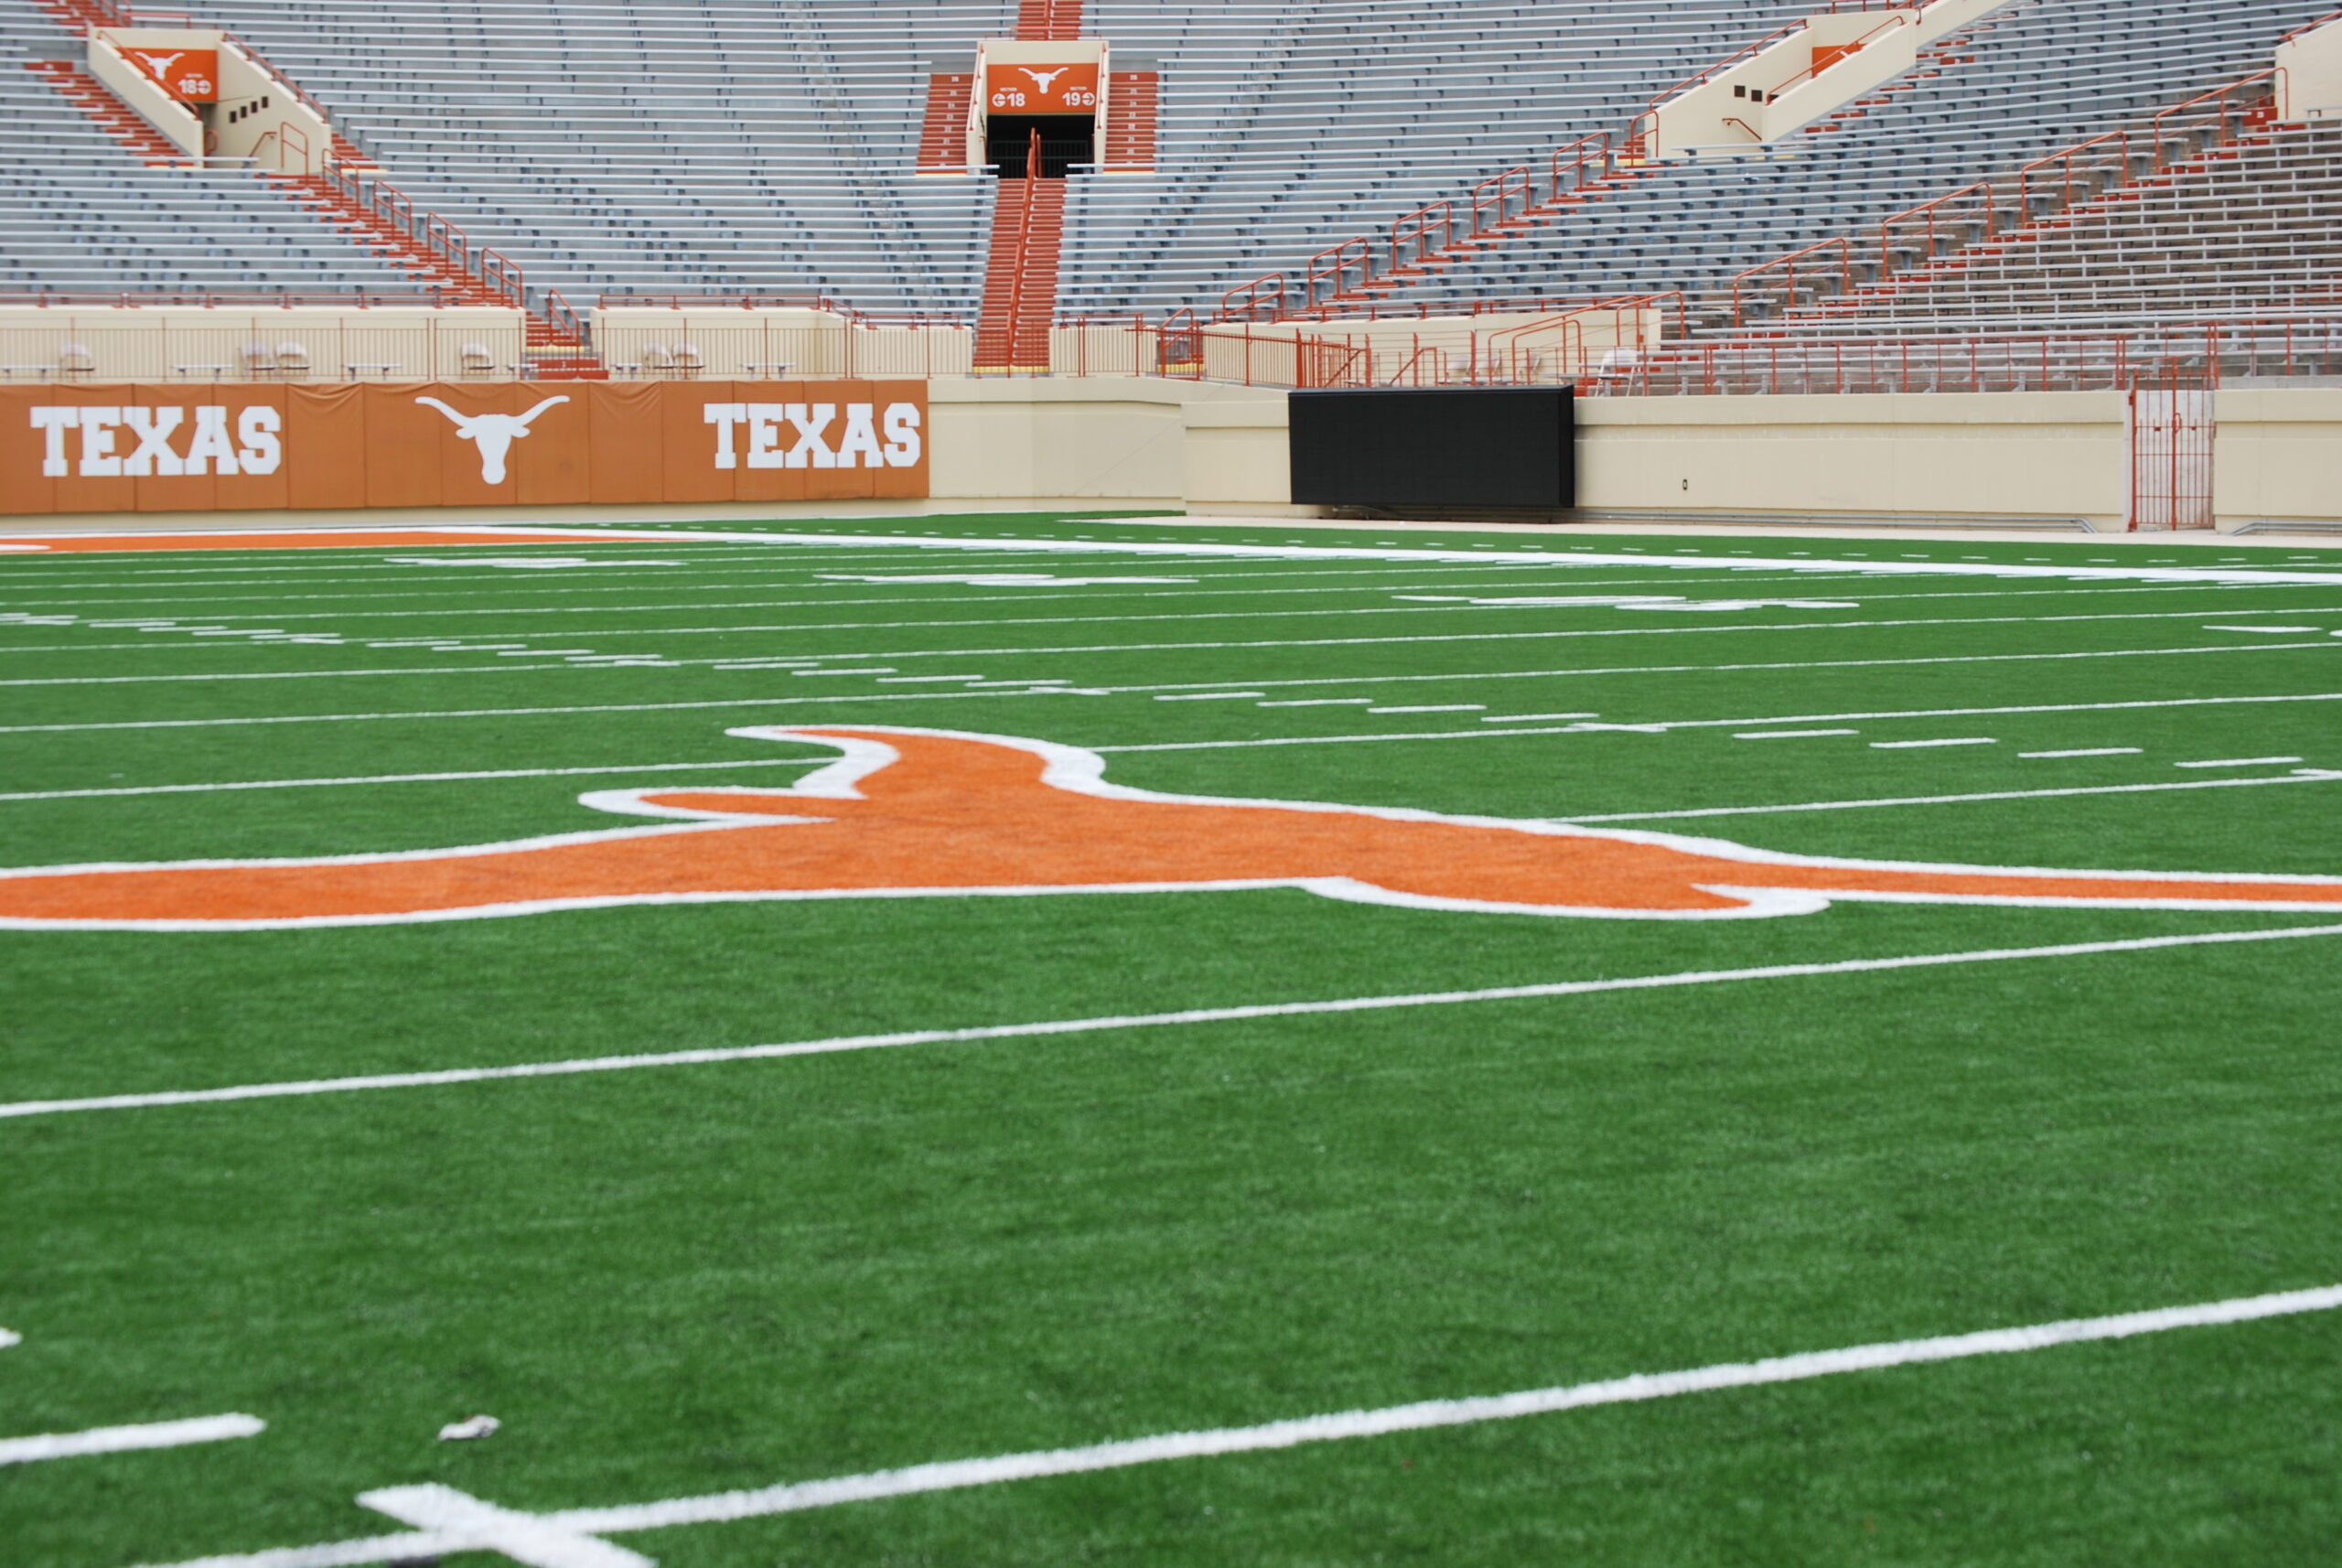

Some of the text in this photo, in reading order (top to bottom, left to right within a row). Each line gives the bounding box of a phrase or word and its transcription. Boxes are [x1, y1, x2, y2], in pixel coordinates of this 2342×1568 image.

[178, 80, 197, 94] 18
[1006, 92, 1025, 107] 18
[1062, 92, 1080, 106] 19
[30, 405, 281, 477] TEXAS
[704, 403, 920, 468] TEXAS
